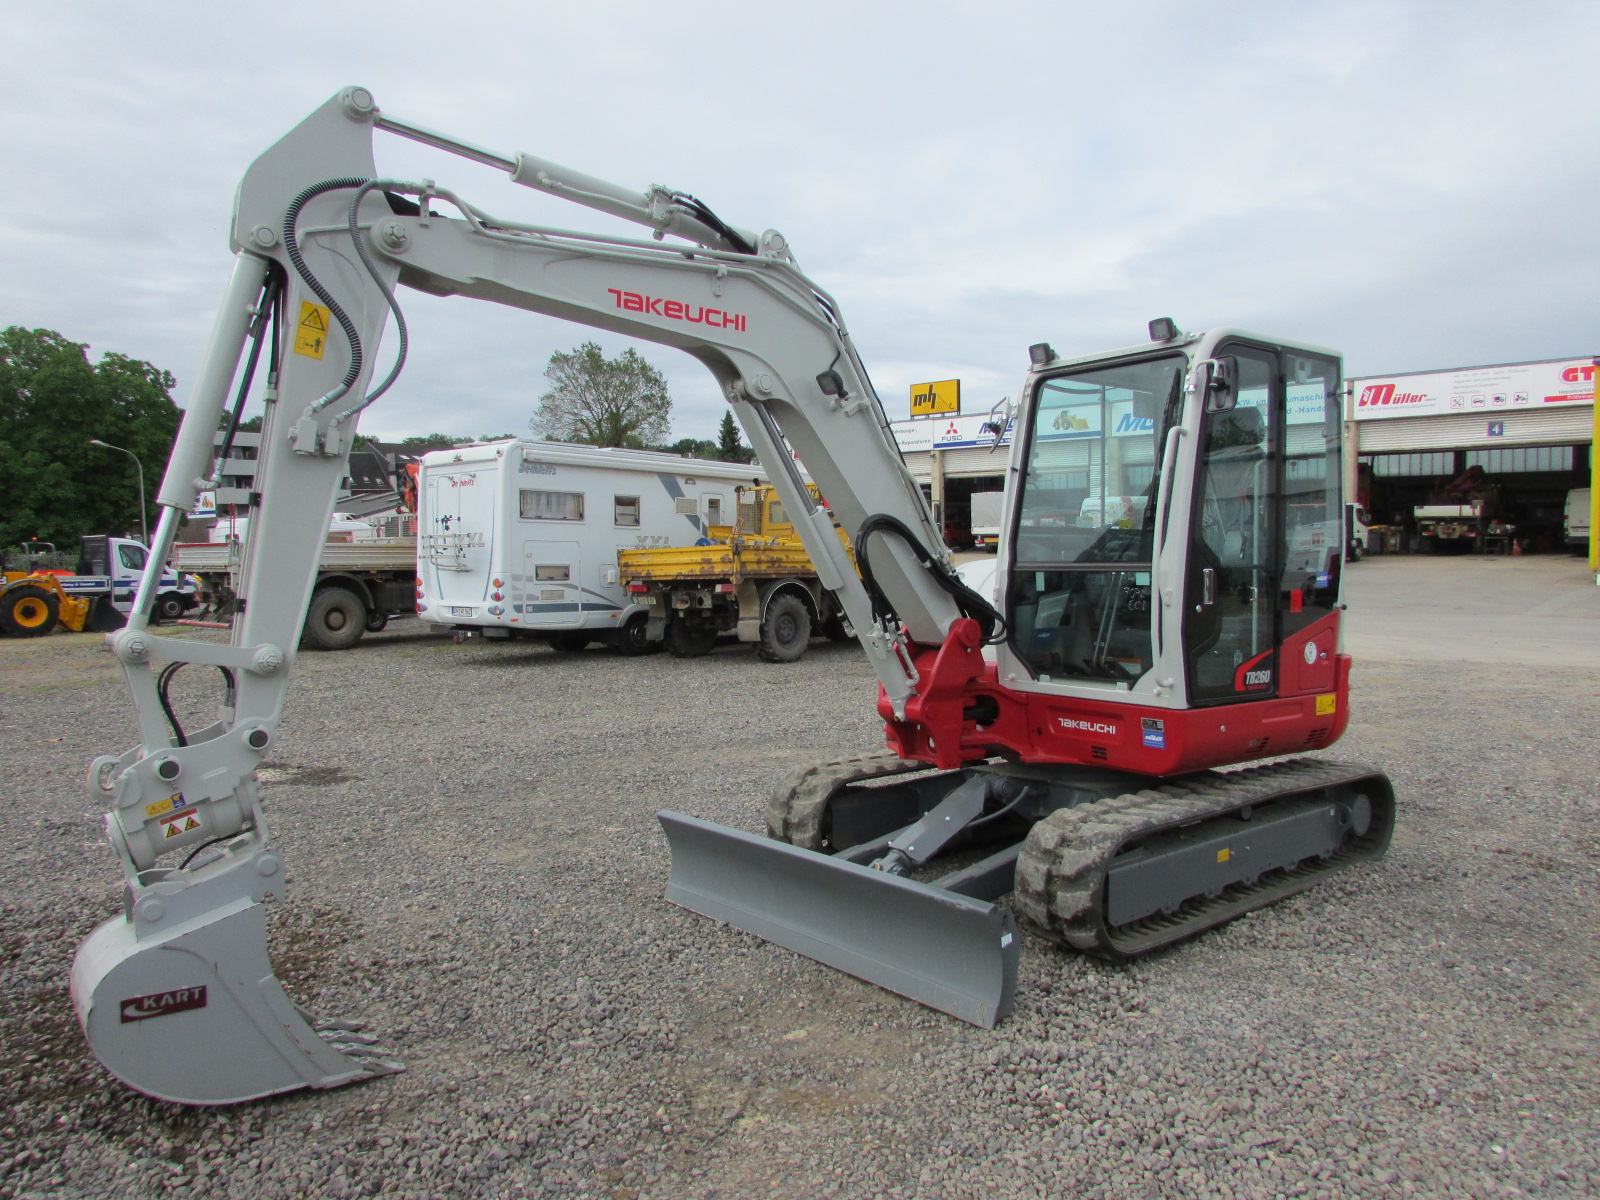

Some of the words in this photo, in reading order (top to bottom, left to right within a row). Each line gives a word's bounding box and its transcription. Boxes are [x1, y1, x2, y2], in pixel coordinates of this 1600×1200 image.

[607, 288, 746, 332] TAKEUCHI
[1246, 670, 1271, 684] TB260
[1058, 718, 1116, 734] TAKEUCHI
[143, 987, 203, 1010] KART
